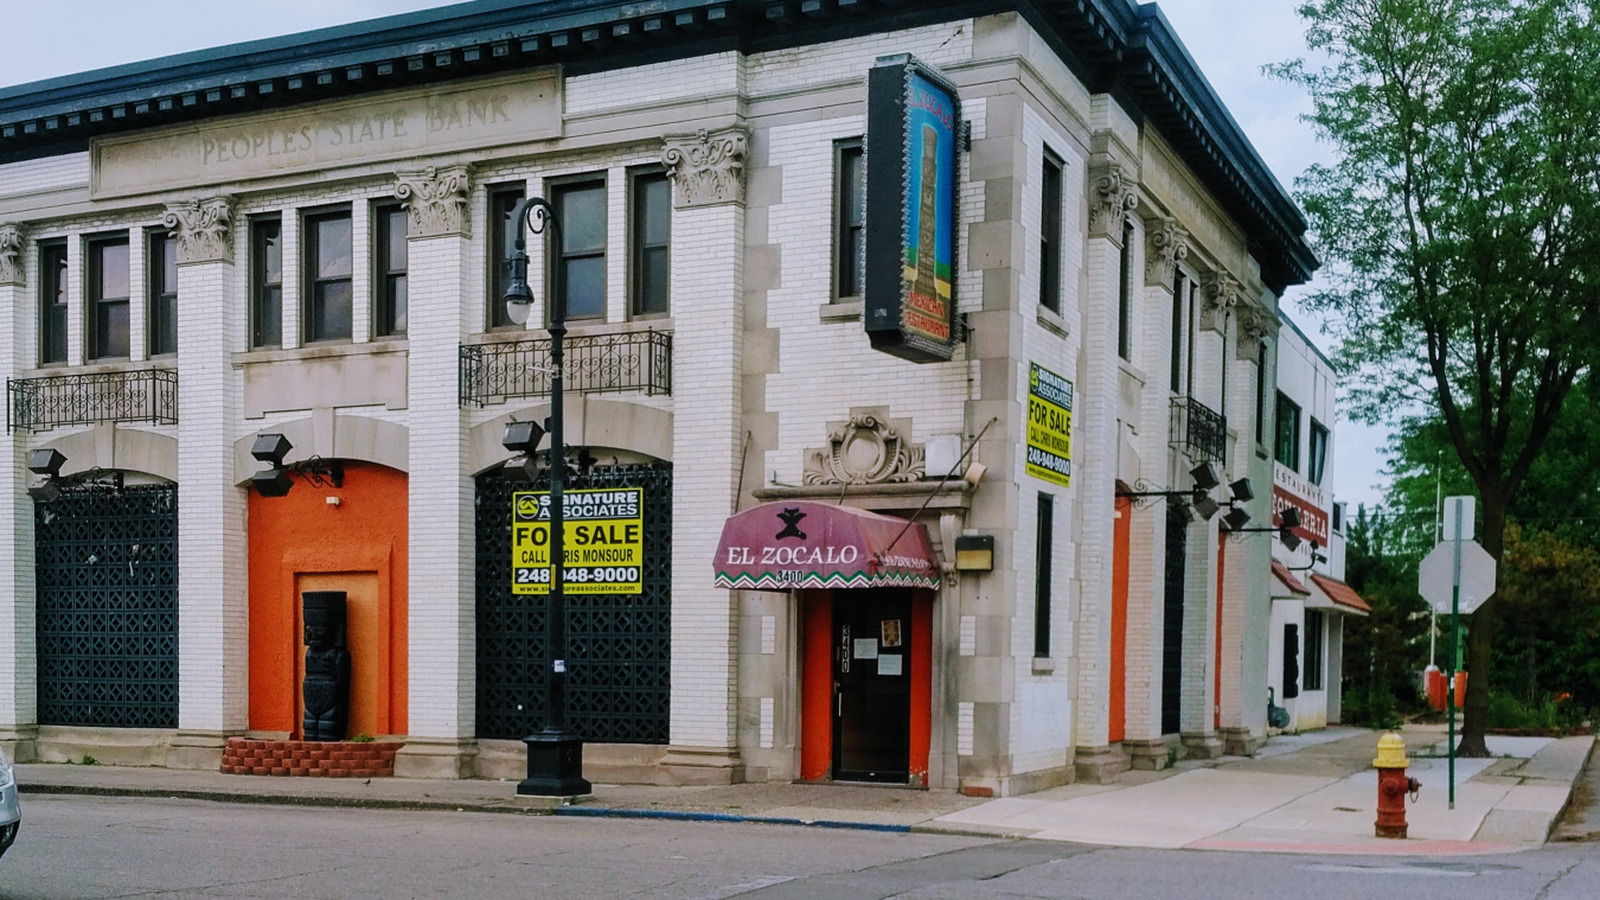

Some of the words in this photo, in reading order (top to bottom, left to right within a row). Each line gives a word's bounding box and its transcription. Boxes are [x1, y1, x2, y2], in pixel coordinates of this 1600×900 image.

[329, 106, 408, 147] STATE
[427, 95, 512, 132] BANK
[908, 291, 945, 317] MEXICAN
[1038, 382, 1072, 408] ASSOCIATES
[1029, 399, 1047, 428] FOR
[1049, 409, 1071, 437] SALE
[1028, 446, 1070, 475] 248-948-9000
[539, 492, 638, 506] SNATURE
[539, 503, 638, 518] ASOCIATES
[516, 526, 566, 546] FO
[574, 524, 639, 545] SALE
[521, 550, 547, 563] CALL
[582, 548, 633, 562] MONSOUR
[727, 546, 755, 565] EL
[761, 545, 858, 565] ZOCALO
[517, 567, 639, 583] 24848-9000
[776, 570, 804, 583] 3400
[519, 584, 635, 592] www.siureassociates.com
[842, 624, 851, 673] 3400
